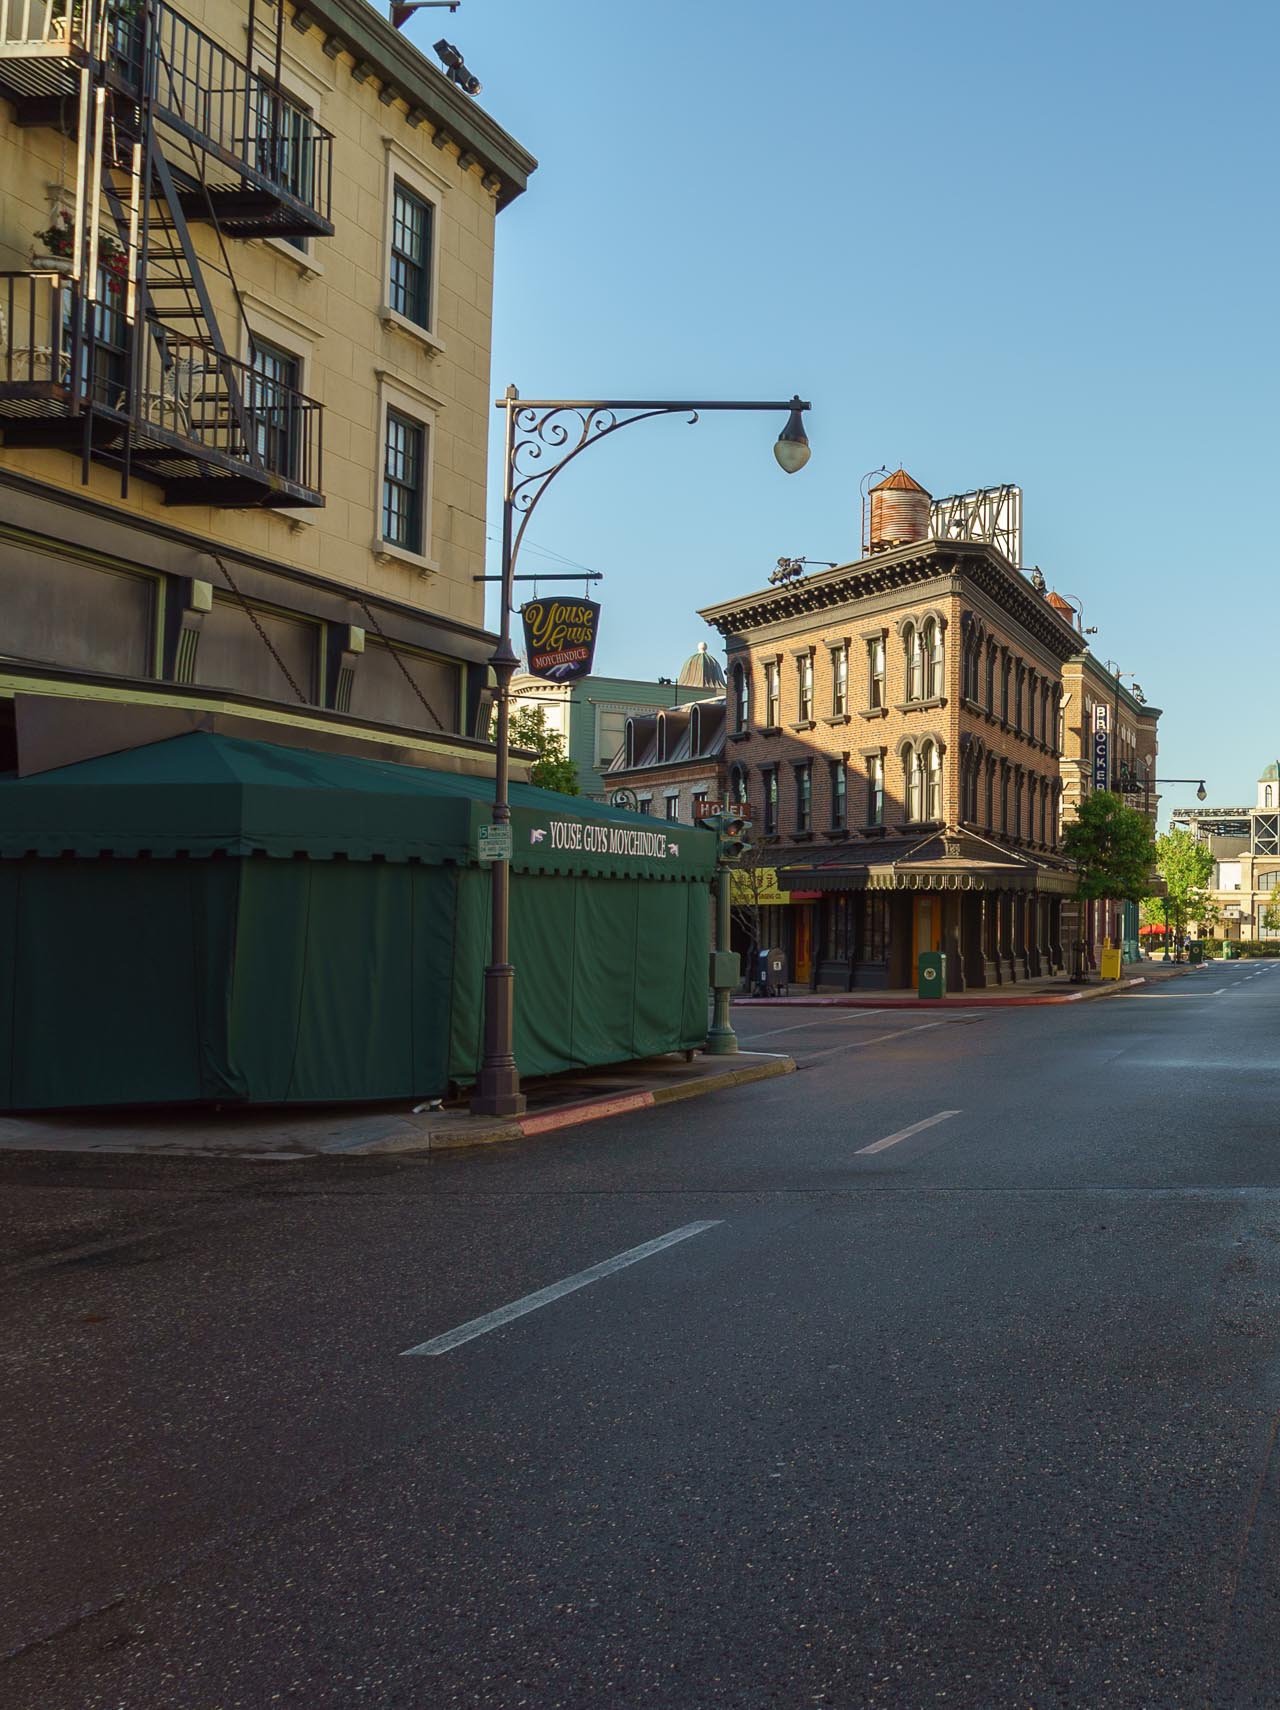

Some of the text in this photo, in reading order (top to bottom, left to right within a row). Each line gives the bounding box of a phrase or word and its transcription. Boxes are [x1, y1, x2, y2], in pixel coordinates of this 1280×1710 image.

[525, 603, 593, 647] Youse
[546, 625, 593, 651] Guys
[535, 648, 587, 668] MOYCHINDICE
[700, 803, 748, 817] HOEL
[550, 821, 667, 858] YOUSE GUYS MOYCHINDICE
